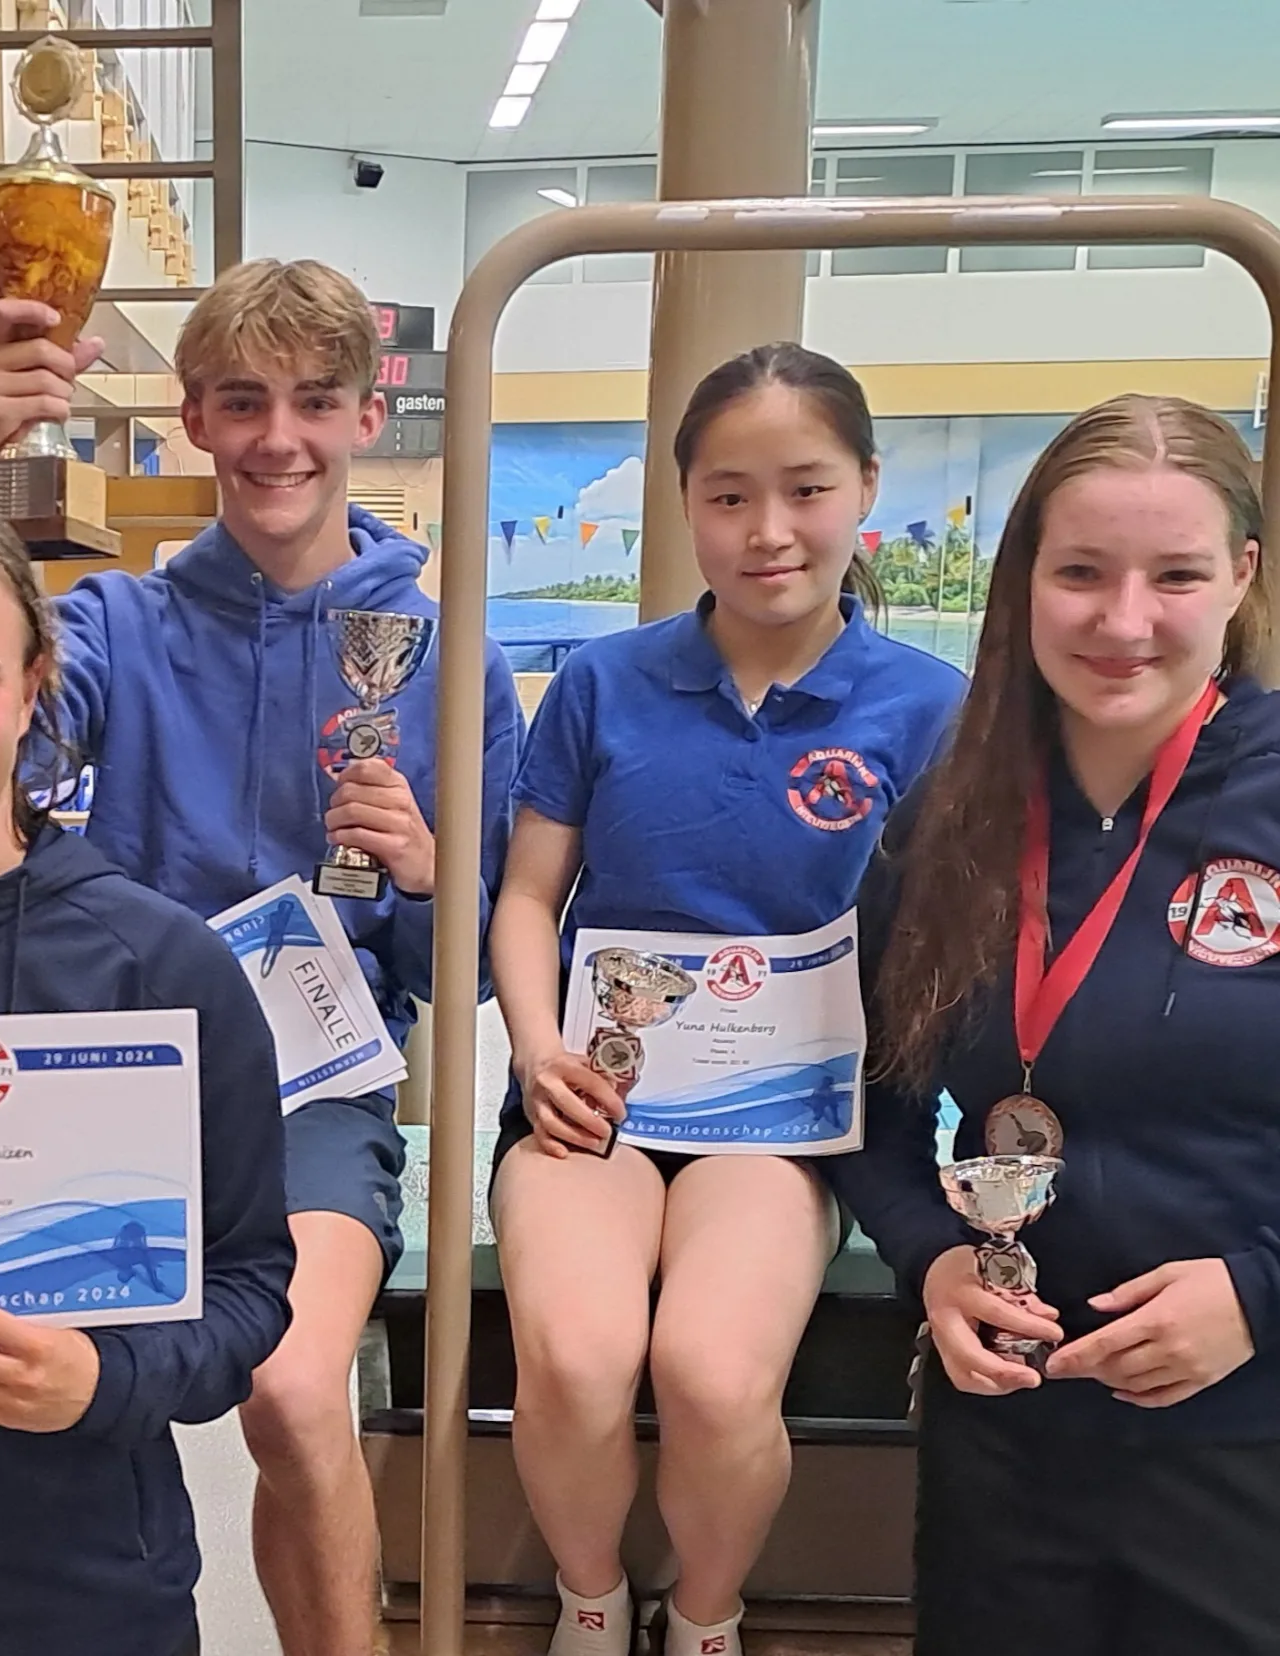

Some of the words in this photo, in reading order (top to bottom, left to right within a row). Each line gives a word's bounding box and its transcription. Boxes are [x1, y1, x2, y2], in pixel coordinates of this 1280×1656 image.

[396, 394, 446, 414] gasten
[1170, 906, 1188, 918] 19
[295, 960, 356, 1050] FINALE
[43, 1053, 64, 1066] 29
[70, 1052, 108, 1065] JUNI
[115, 1050, 155, 1063] 2024
[77, 1285, 131, 1303] 2024
